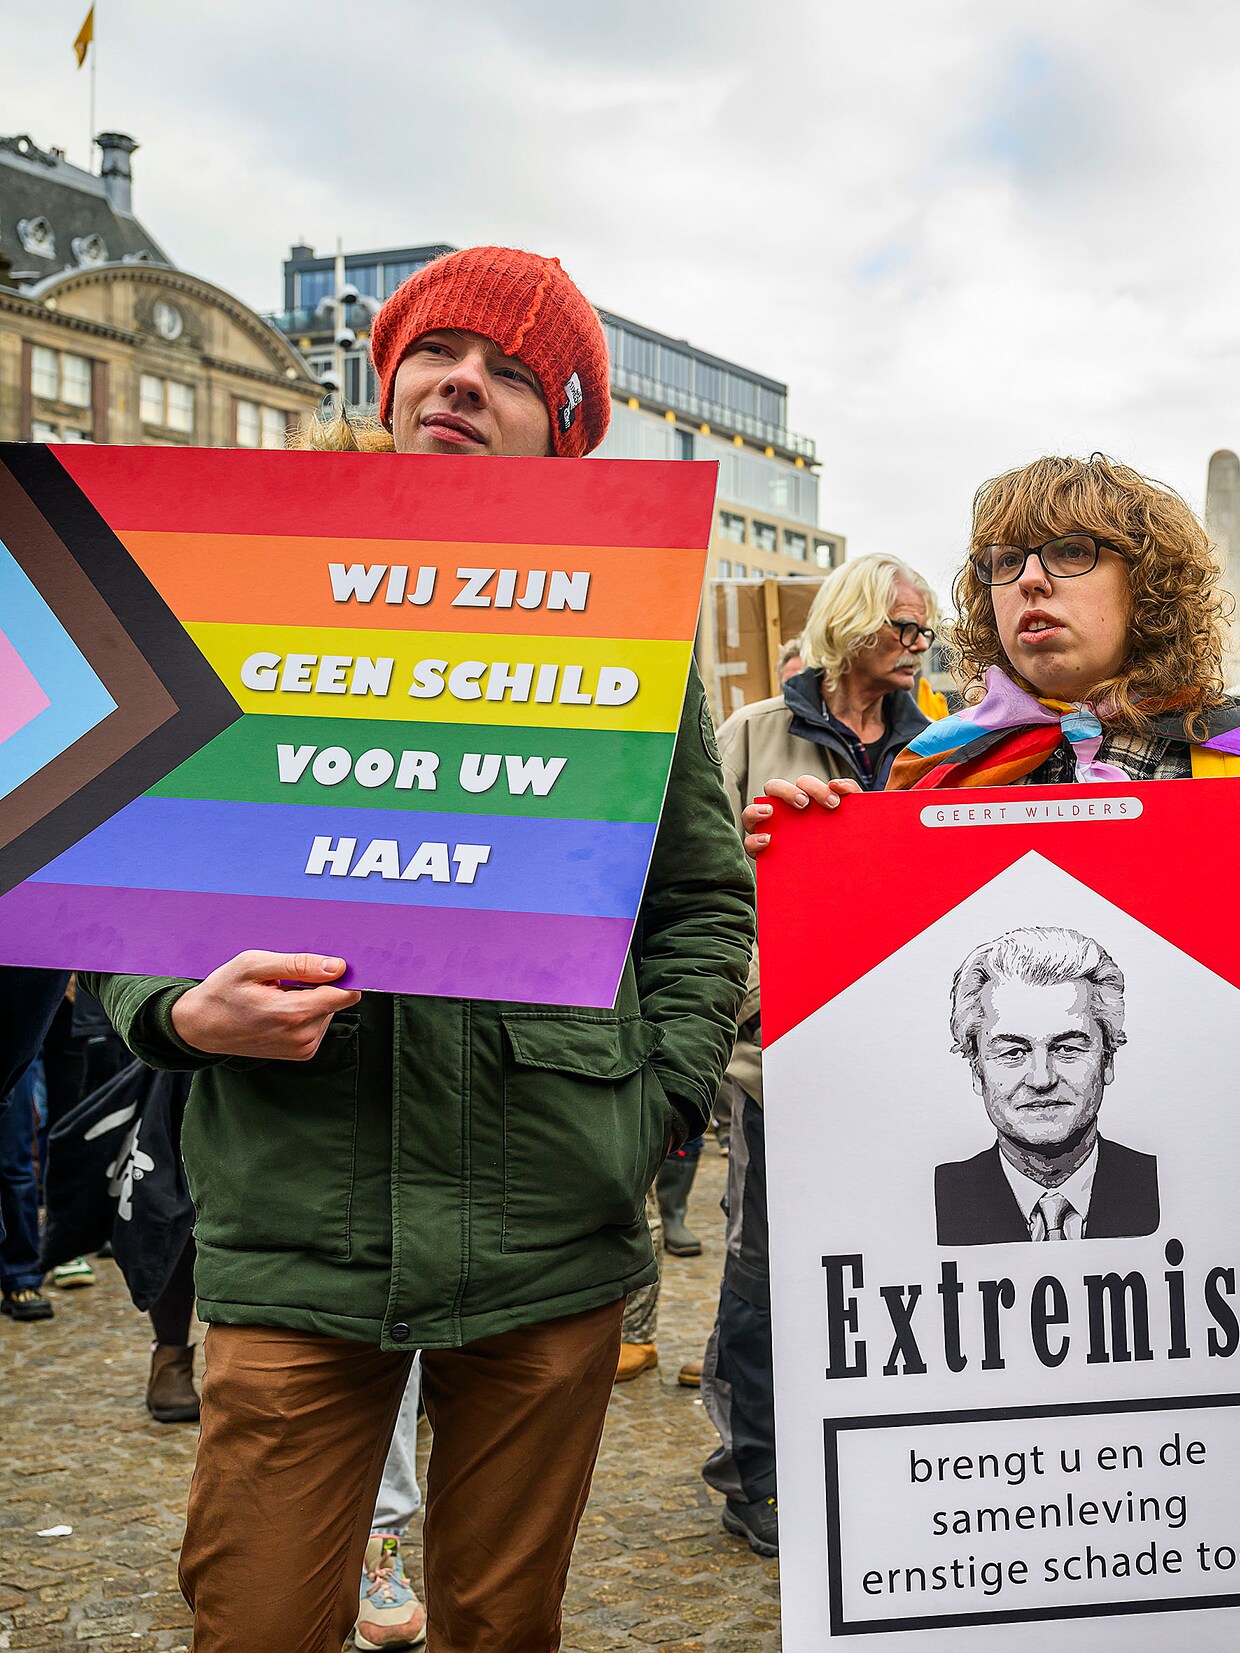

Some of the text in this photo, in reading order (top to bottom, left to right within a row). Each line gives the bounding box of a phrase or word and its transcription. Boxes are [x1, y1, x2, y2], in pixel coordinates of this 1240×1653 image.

[328, 563, 591, 611] WIJ ZIJN
[240, 652, 640, 706] GEEN SCHILD
[277, 745, 568, 797] VOOR UW
[936, 803, 1127, 822] GEERT WILDERS
[304, 836, 491, 884] HAAT
[909, 1433, 1206, 1485] brengt u en de
[932, 1491, 1187, 1536] samenleving
[862, 1556, 1029, 1595] ernstige
[1043, 1542, 1183, 1582] schade
